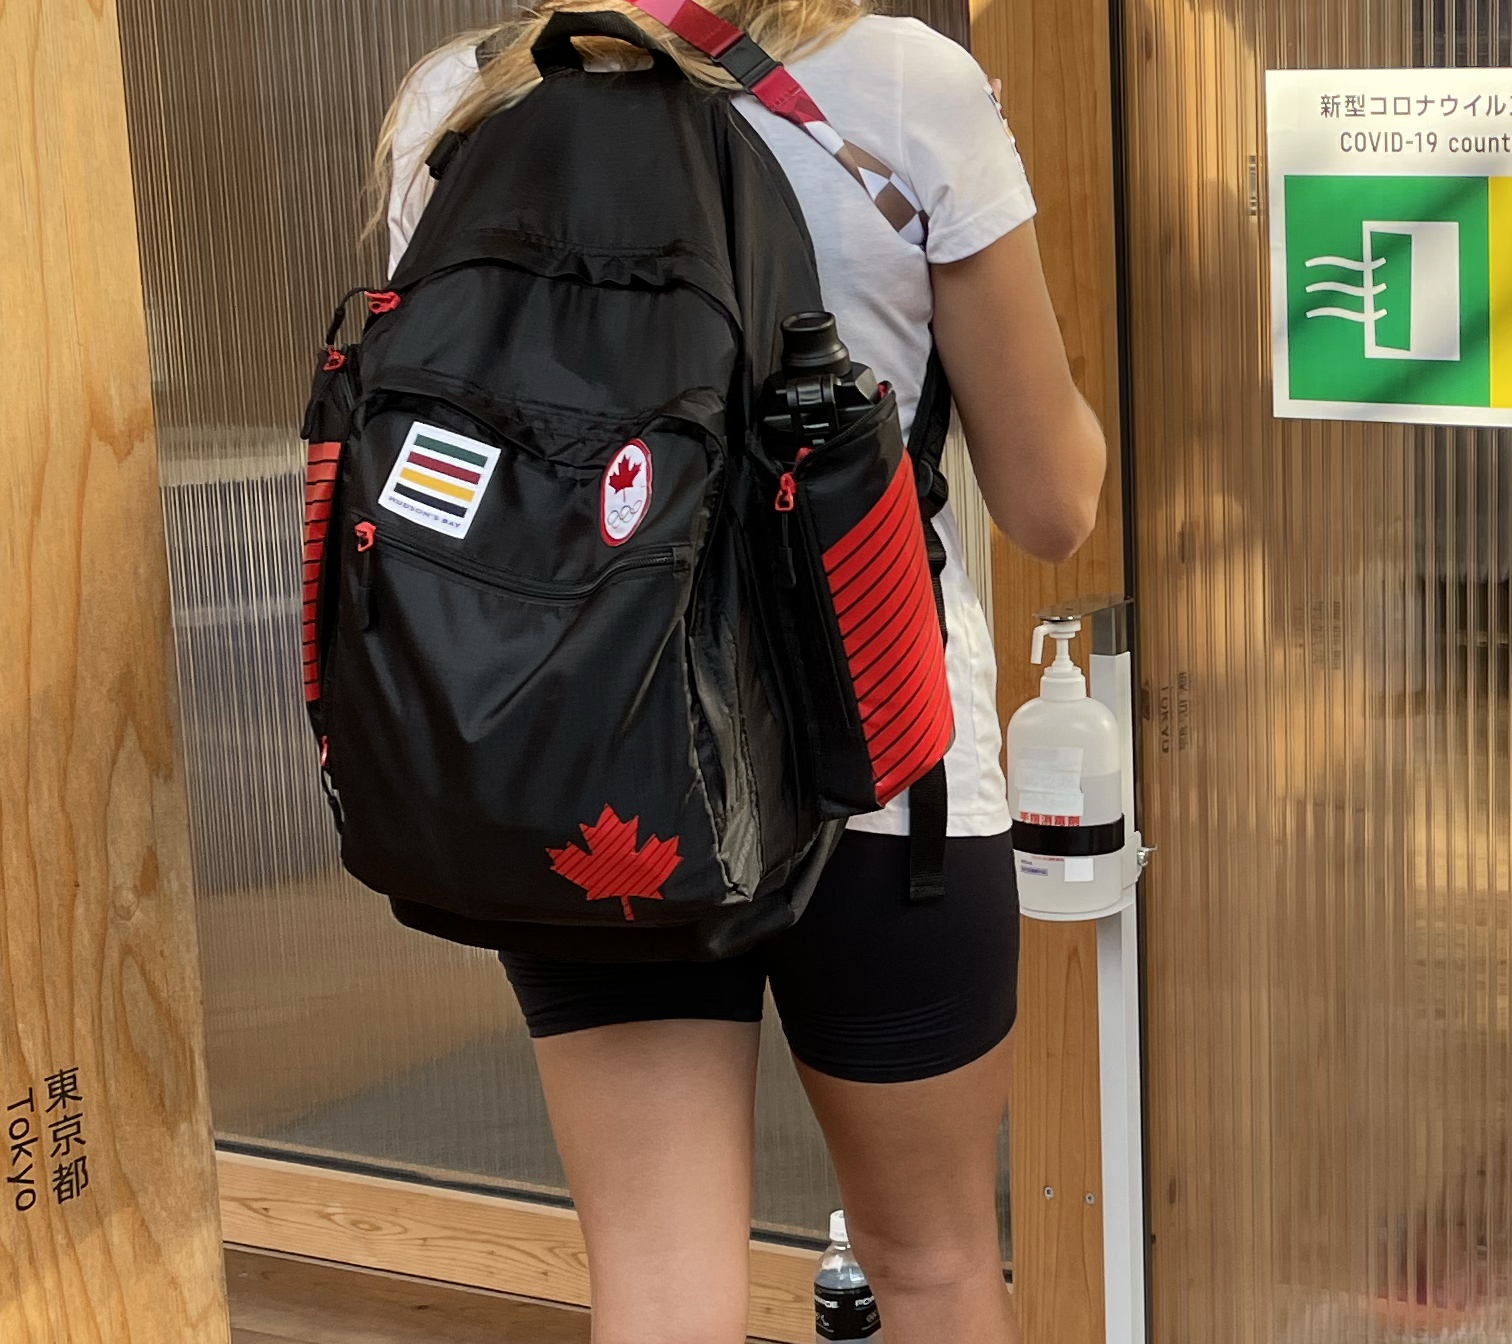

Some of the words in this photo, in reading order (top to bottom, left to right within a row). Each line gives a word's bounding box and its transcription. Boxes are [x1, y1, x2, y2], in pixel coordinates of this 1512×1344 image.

[1340, 131, 1438, 153] COVID-19
[44, 1067, 89, 1205] 東京都
